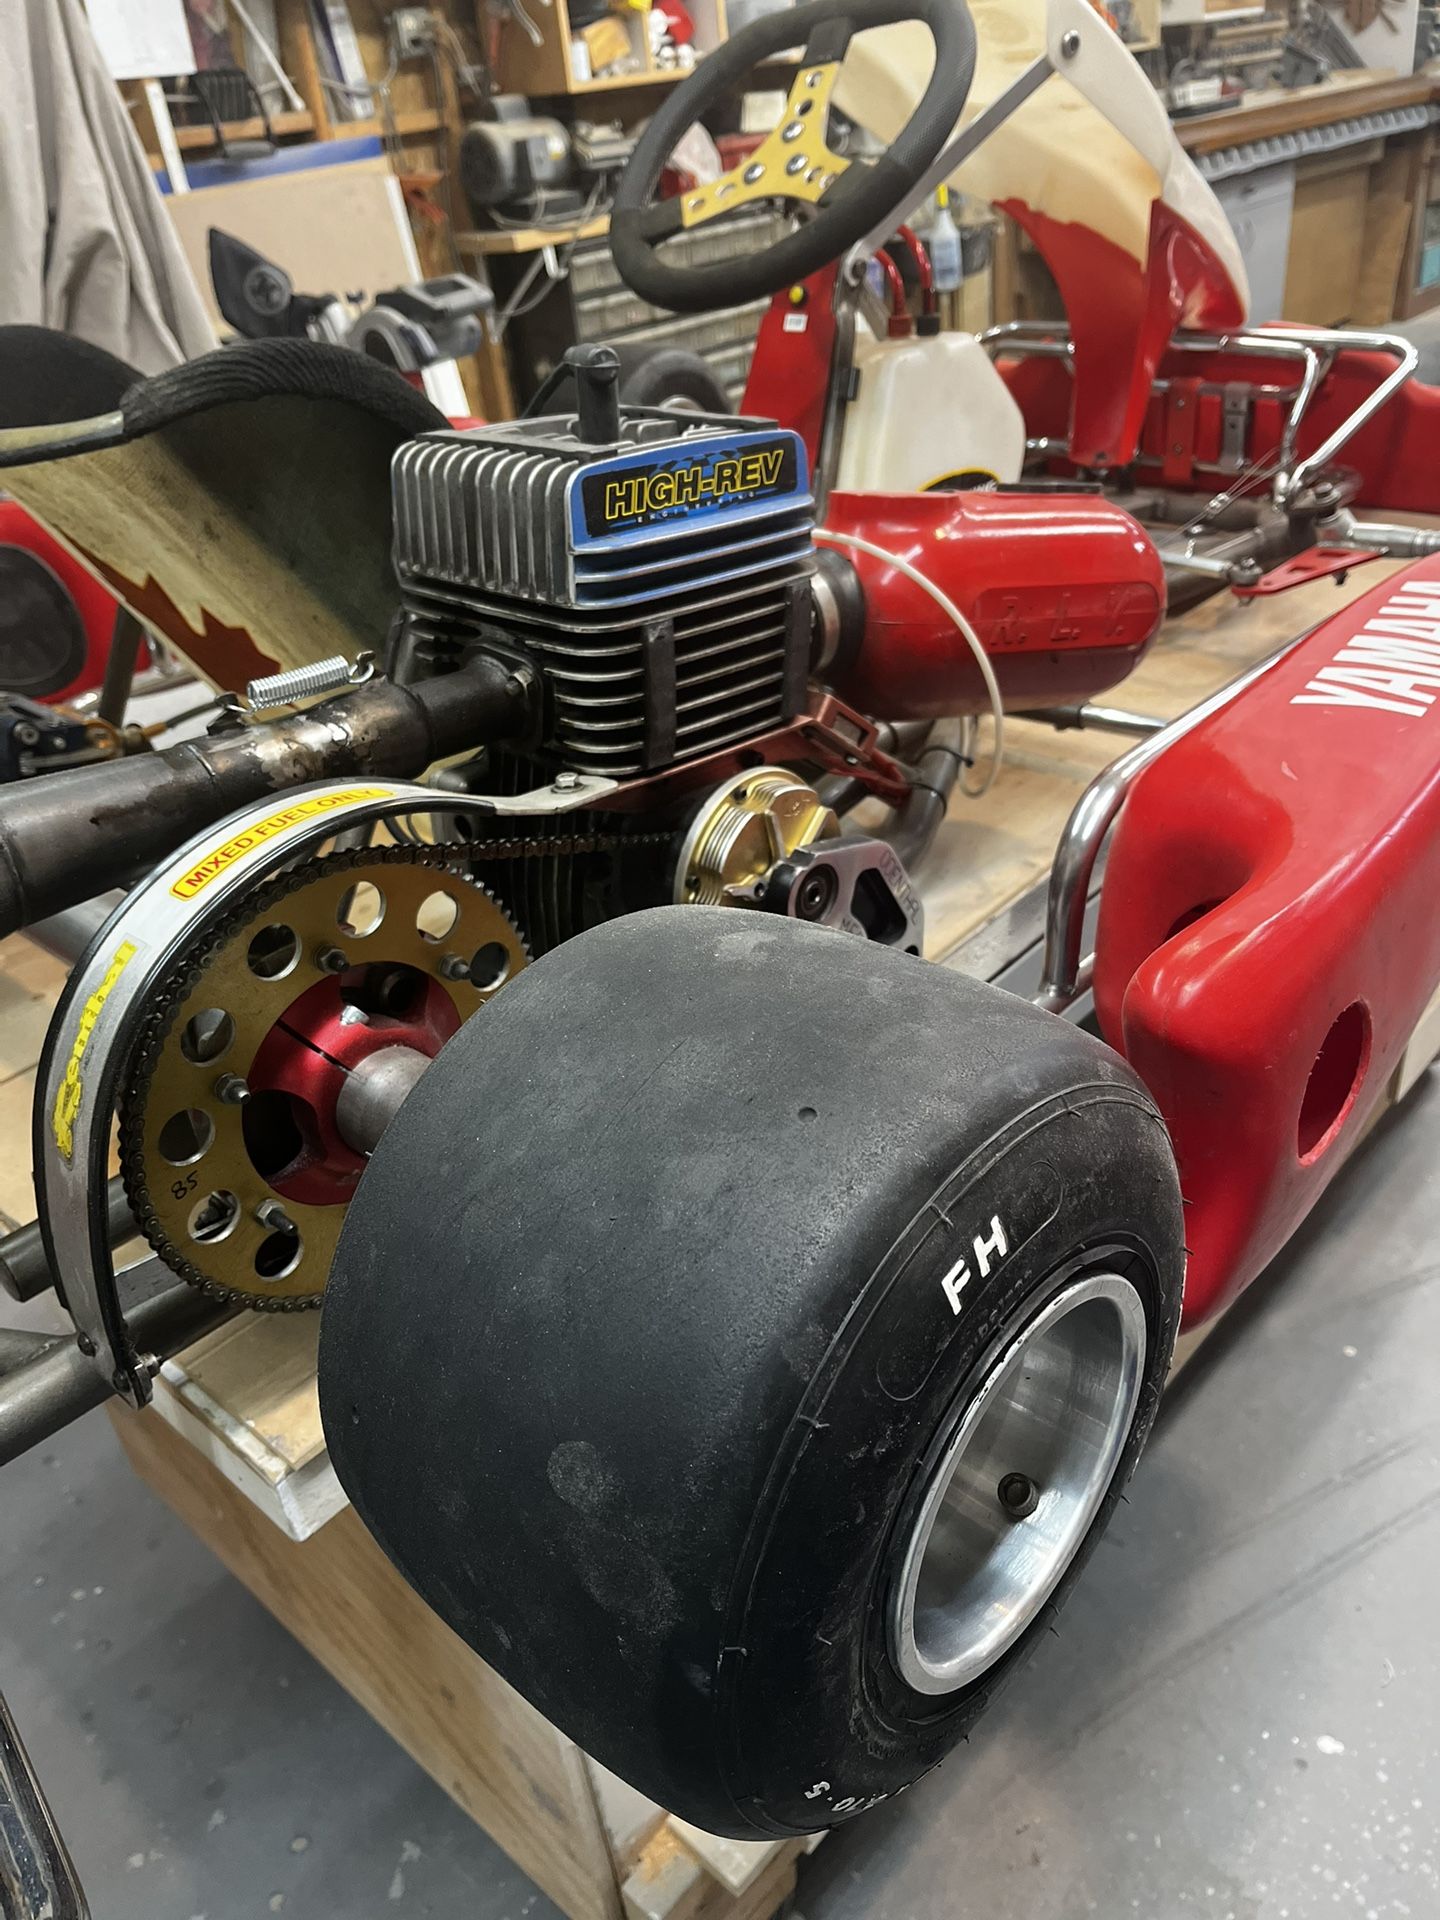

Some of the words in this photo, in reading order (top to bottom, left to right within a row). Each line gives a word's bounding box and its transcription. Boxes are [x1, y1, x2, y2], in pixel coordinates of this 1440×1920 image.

[605, 449, 784, 520] HIGH-REV
[185, 837, 254, 887] MIXED
[255, 807, 315, 836] FUEL
[317, 789, 375, 808] ONLY
[171, 1170, 198, 1200] 85
[941, 1215, 1008, 1315] FH
